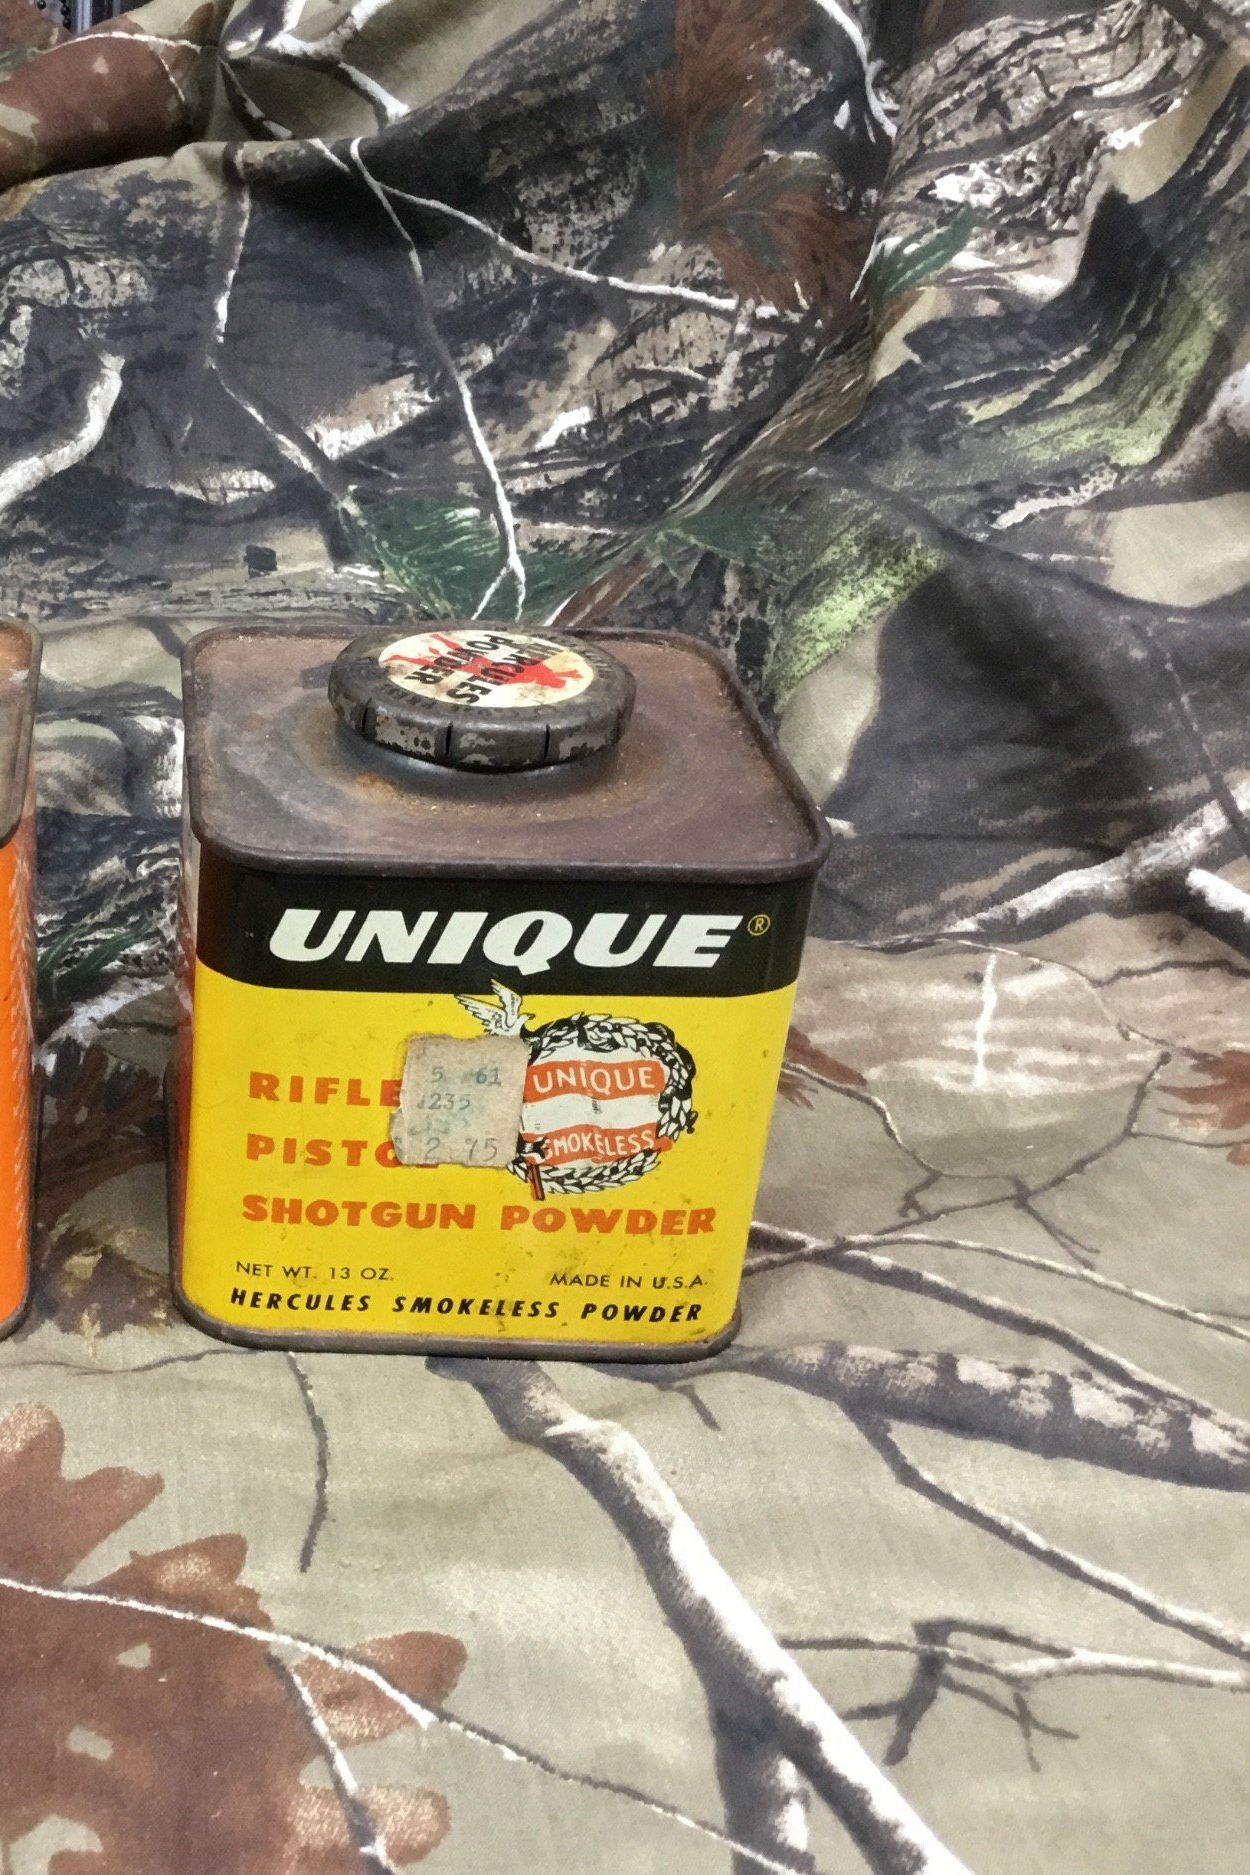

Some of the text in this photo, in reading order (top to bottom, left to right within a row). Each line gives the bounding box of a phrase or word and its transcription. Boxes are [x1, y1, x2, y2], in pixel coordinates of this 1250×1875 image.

[405, 634, 516, 685] POWDER
[446, 643, 565, 704] HERCULES
[249, 1071, 401, 1107] RIFLE
[532, 1065, 656, 1096] UNIQUE
[246, 1133, 438, 1168] PISTO
[543, 1129, 655, 1160] SMOKELESS
[241, 1194, 717, 1236] SHOTGUN POWDER
[235, 1260, 395, 1281] NET WT. 13 OZ.
[549, 1273, 611, 1288] MADE
[619, 1274, 643, 1288] IN
[230, 1287, 703, 1323] HERCULES SMOKELESS POWDER
